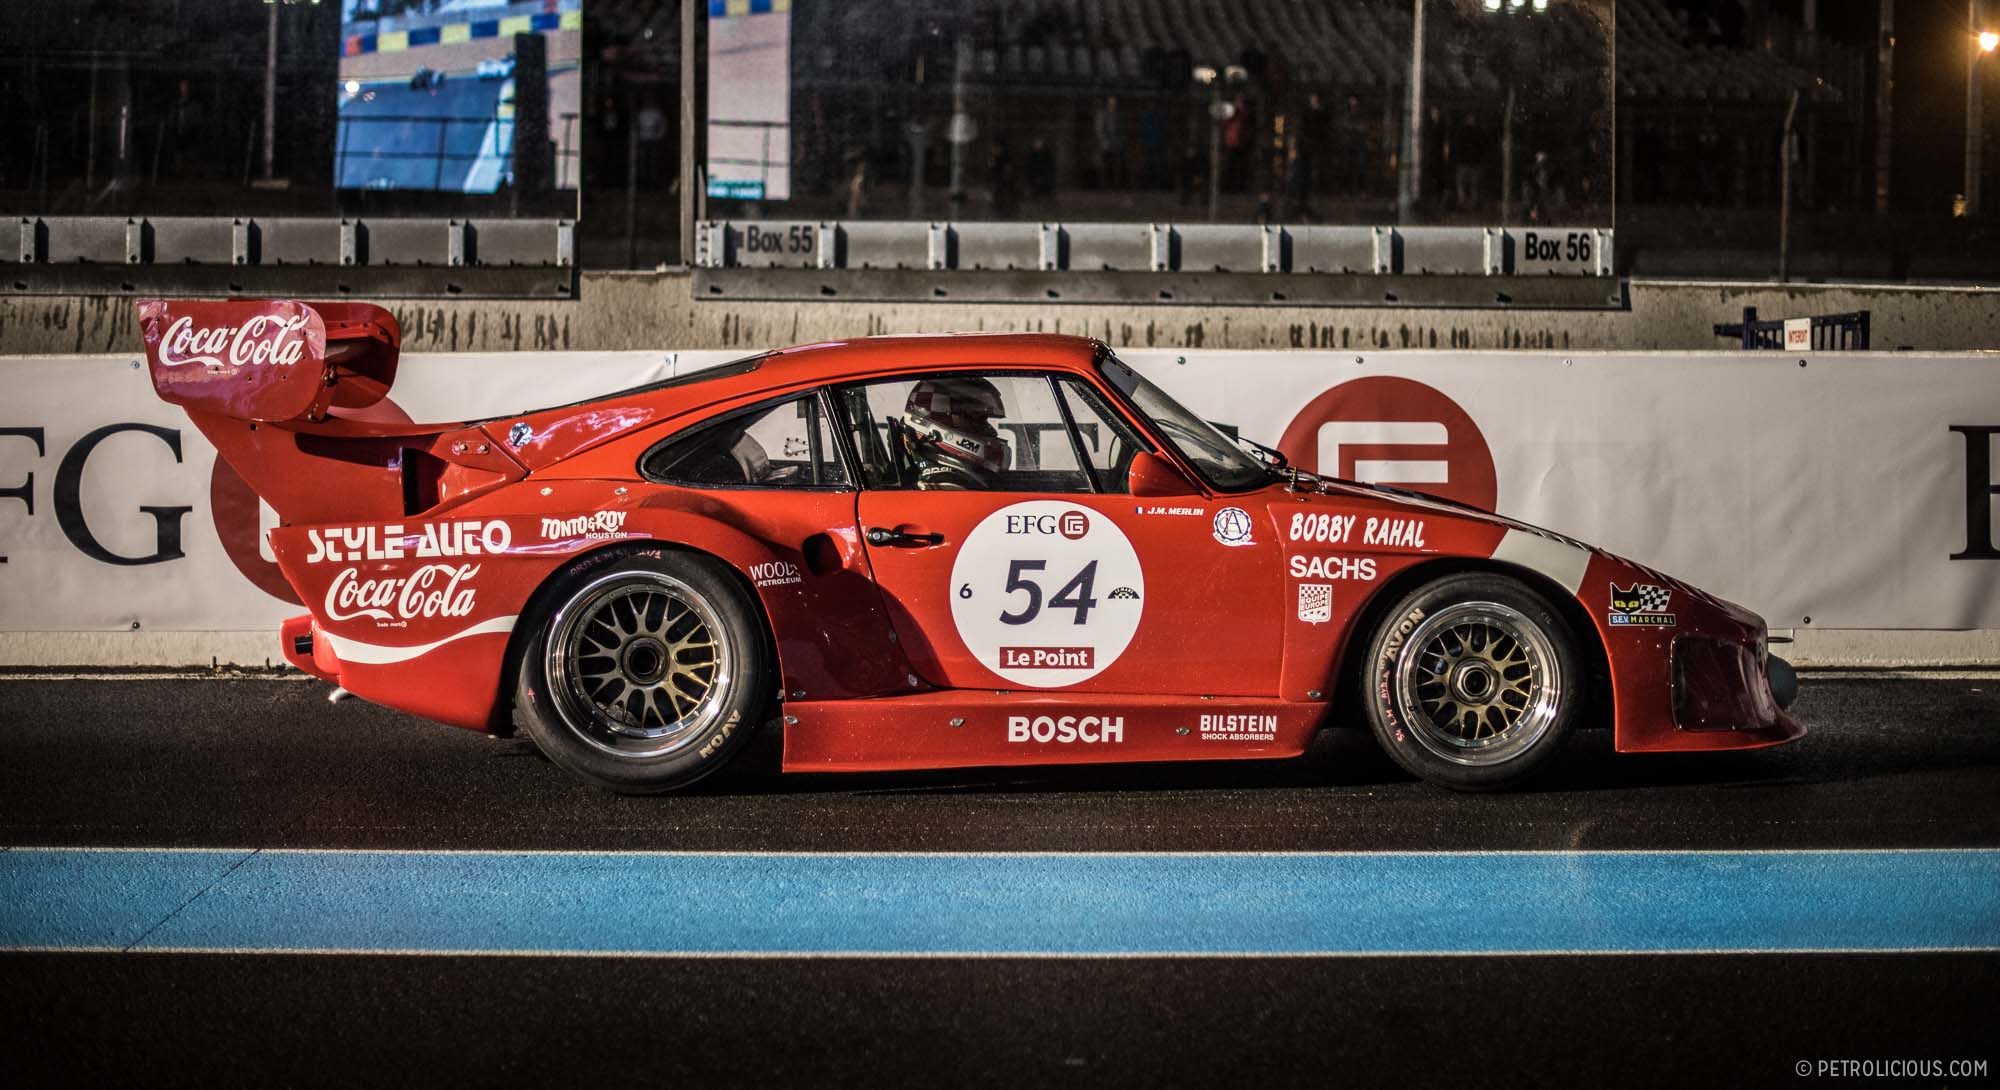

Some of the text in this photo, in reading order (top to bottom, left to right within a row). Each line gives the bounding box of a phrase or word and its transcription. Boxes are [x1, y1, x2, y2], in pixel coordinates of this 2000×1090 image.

[747, 225, 813, 254] Box 55
[1525, 231, 1591, 261] Box 56
[158, 315, 311, 367] Coca-Cola
[585, 531, 628, 540] HOUSTON
[1005, 514, 1057, 535] EFG
[1289, 512, 1357, 543] BOBBY
[1363, 517, 1425, 548] RAHAL
[306, 519, 512, 564] STYLE AUTO
[757, 576, 802, 588] PETROLEUM
[1289, 554, 1377, 581] SACHS
[324, 563, 482, 621] Coca-Cola
[959, 583, 973, 600] 6
[999, 559, 1099, 626] 54
[1630, 615, 1674, 625] MARCHAL
[1385, 607, 1426, 663] AVON
[1006, 648, 1088, 667] Le Point
[698, 708, 742, 759] AVON
[1008, 715, 1124, 744] BOSCH
[1200, 714, 1278, 733] BILSTEIN
[1201, 733, 1275, 742] SHOCK ABSORBERS
